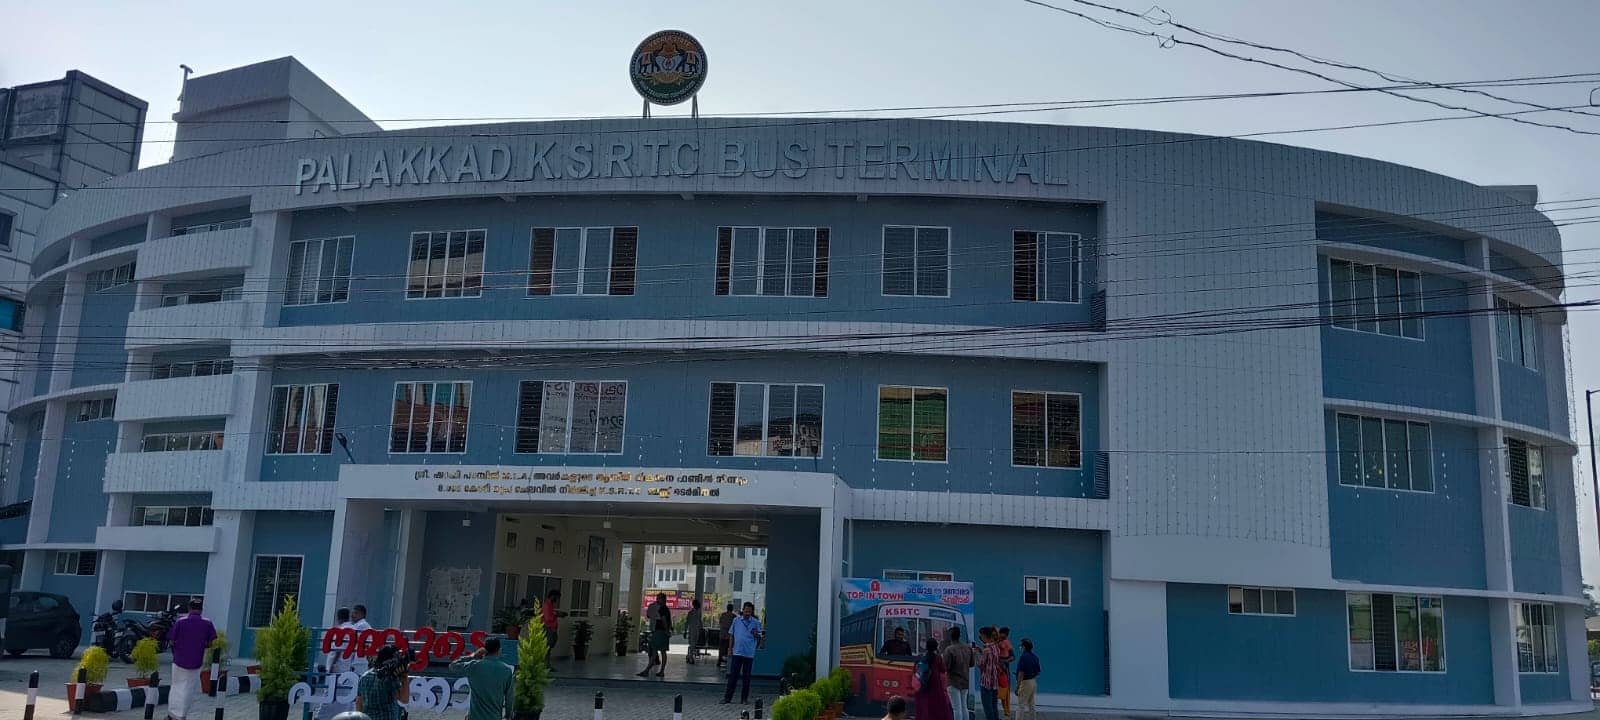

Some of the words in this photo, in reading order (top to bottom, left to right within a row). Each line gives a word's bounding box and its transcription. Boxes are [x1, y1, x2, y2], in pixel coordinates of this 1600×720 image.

[296, 144, 512, 195] PALAKKAD
[531, 138, 699, 180] K.S.R.T.C
[719, 139, 808, 178] BUS
[828, 141, 1068, 186] TERMINAL
[847, 591, 865, 599] TOP
[866, 592, 875, 600] IN
[877, 592, 904, 601] TOWN
[885, 608, 920, 617] KSRTC
